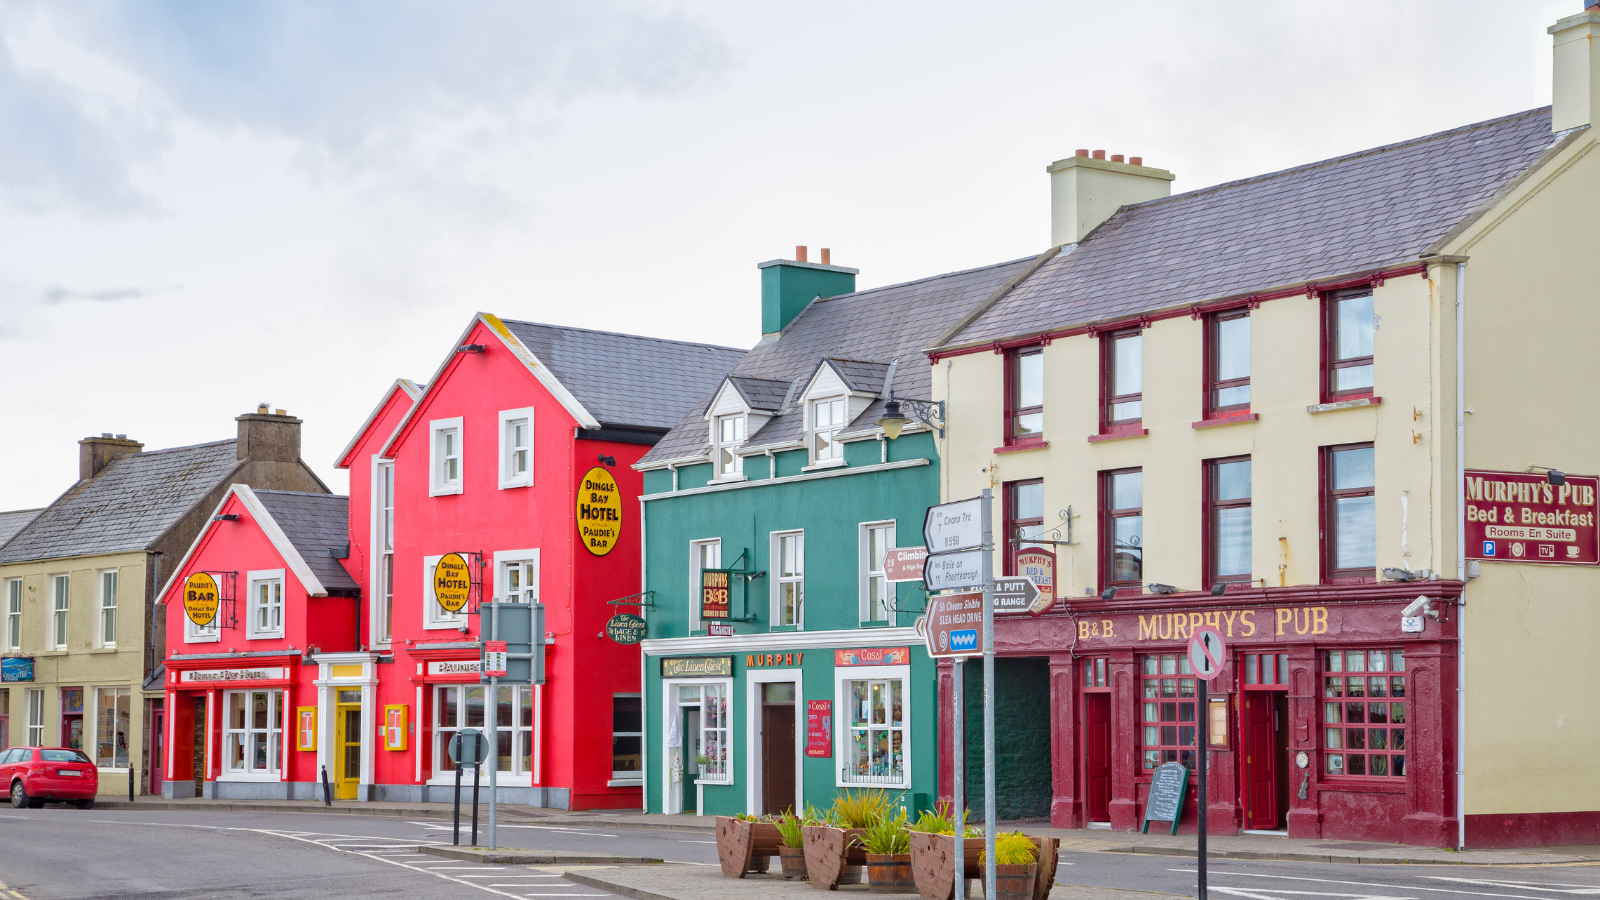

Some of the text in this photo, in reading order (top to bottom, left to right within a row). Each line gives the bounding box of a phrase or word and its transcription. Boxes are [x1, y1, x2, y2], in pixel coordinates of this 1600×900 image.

[585, 480, 614, 492] DINGLE
[1466, 477, 1594, 506] MURPHY'S PUB
[590, 493, 609, 504] BAY
[580, 503, 618, 521] HOTEL
[1467, 505, 1594, 527] Bed & Breakfast
[944, 516, 960, 526] Ceann
[1490, 527, 1571, 539] Rooms En Suite
[590, 538, 607, 547] BAR
[898, 550, 929, 561] Climbin
[942, 561, 954, 570] Baile
[1019, 556, 1051, 568] MURPHY'S
[1026, 567, 1038, 575] BED
[438, 578, 468, 589] HOTEL
[996, 583, 1002, 592] &
[1004, 583, 1025, 591] PUTT
[187, 591, 214, 602] BAR
[703, 589, 728, 604] B&B
[1001, 598, 1025, 606] RANGE
[939, 612, 981, 625] SLEA HEAD DRIVE
[1138, 607, 1328, 640] MURPHY'S PUB
[747, 653, 803, 667] MURPHY
[672, 659, 722, 674] The Linen Chest
